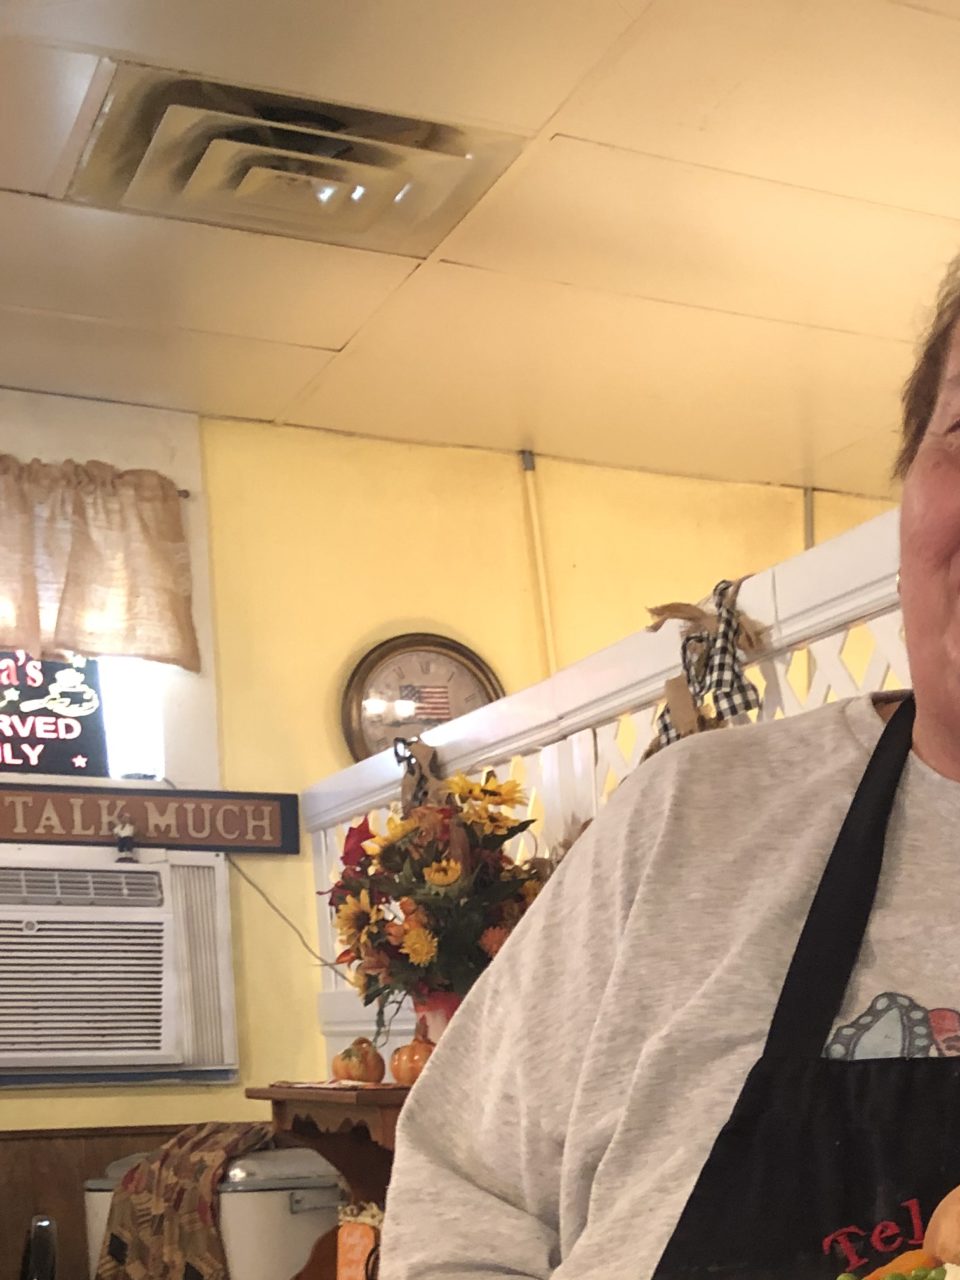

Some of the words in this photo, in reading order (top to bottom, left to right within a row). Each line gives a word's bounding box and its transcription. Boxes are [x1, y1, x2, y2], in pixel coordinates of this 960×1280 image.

[0, 649, 43, 687] a's
[0, 714, 82, 740] RVED
[0, 742, 45, 766] LY
[4, 796, 128, 836] TALK
[144, 800, 274, 841] MUCH
[822, 1198, 924, 1272] Tel
